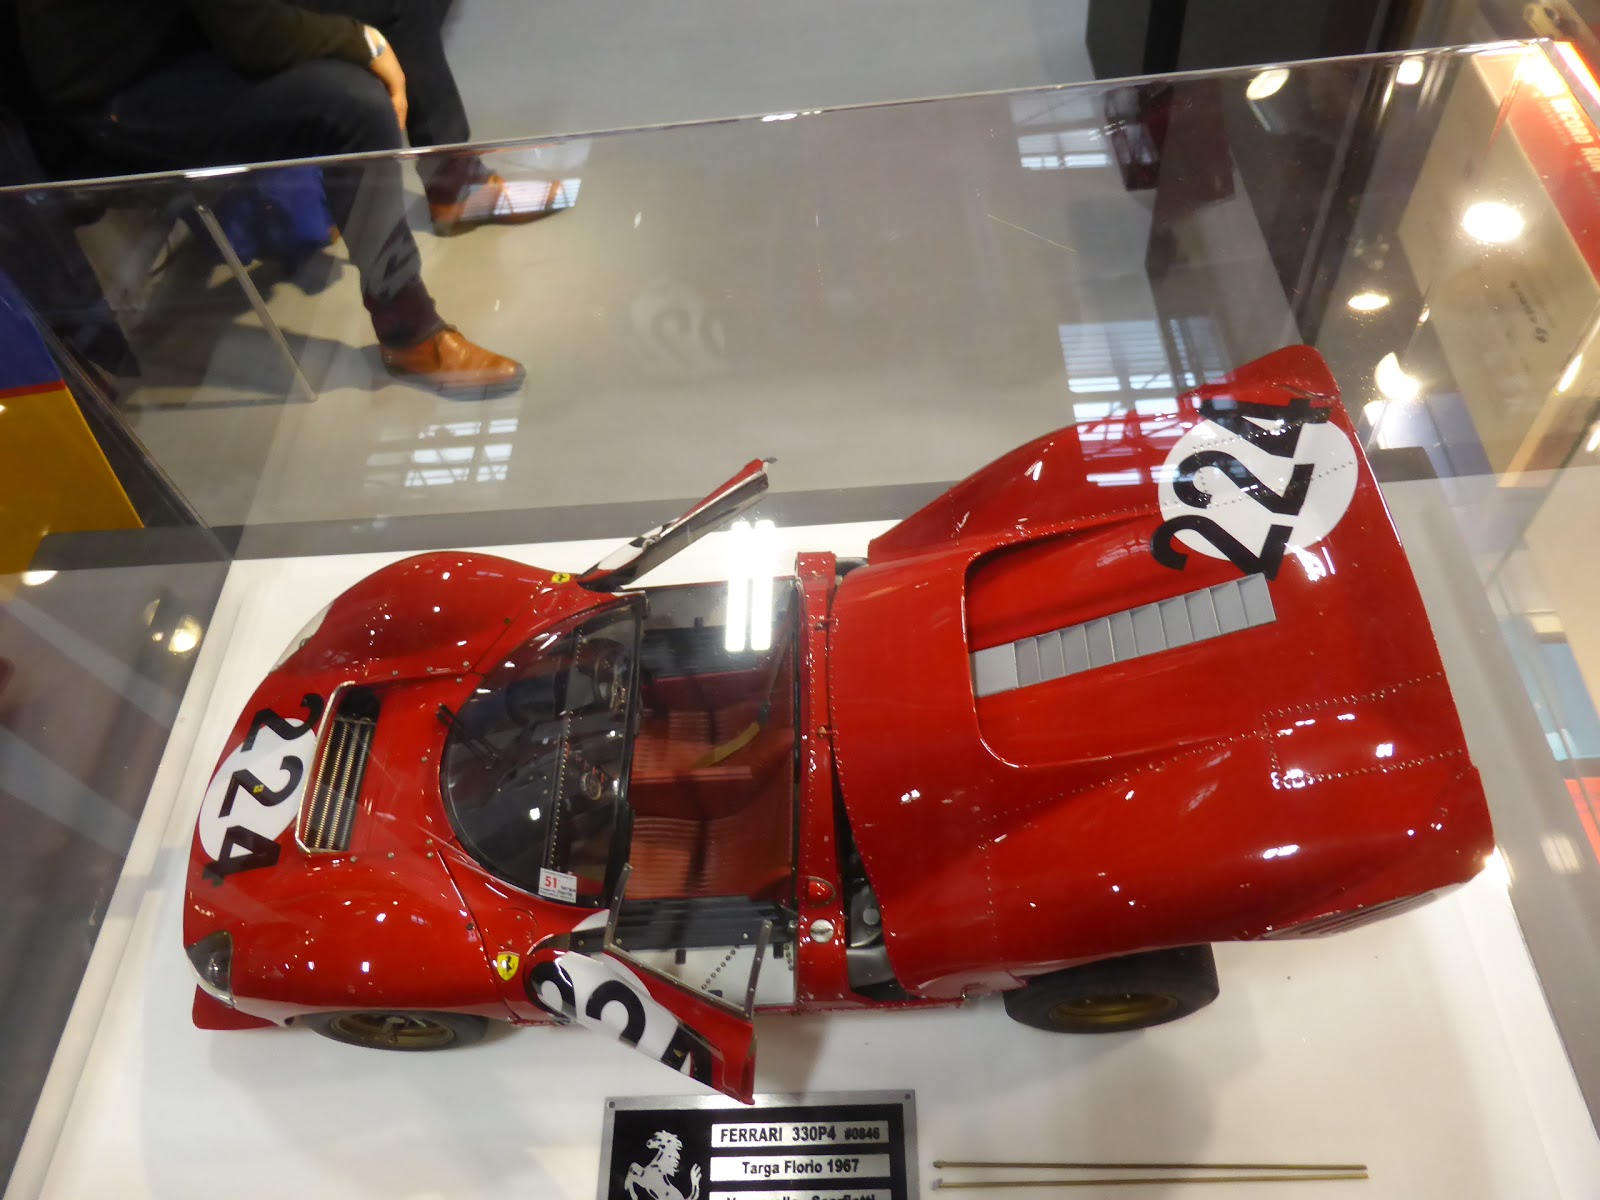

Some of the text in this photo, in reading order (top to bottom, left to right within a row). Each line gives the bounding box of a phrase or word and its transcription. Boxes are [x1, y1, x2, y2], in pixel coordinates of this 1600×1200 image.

[1150, 397, 1332, 581] 224
[202, 693, 324, 886] 224
[545, 875, 557, 889] 51
[720, 1127, 783, 1142] FERRARI
[792, 1125, 837, 1142] 330P4
[742, 1158, 860, 1177] Targa Florio 1967
